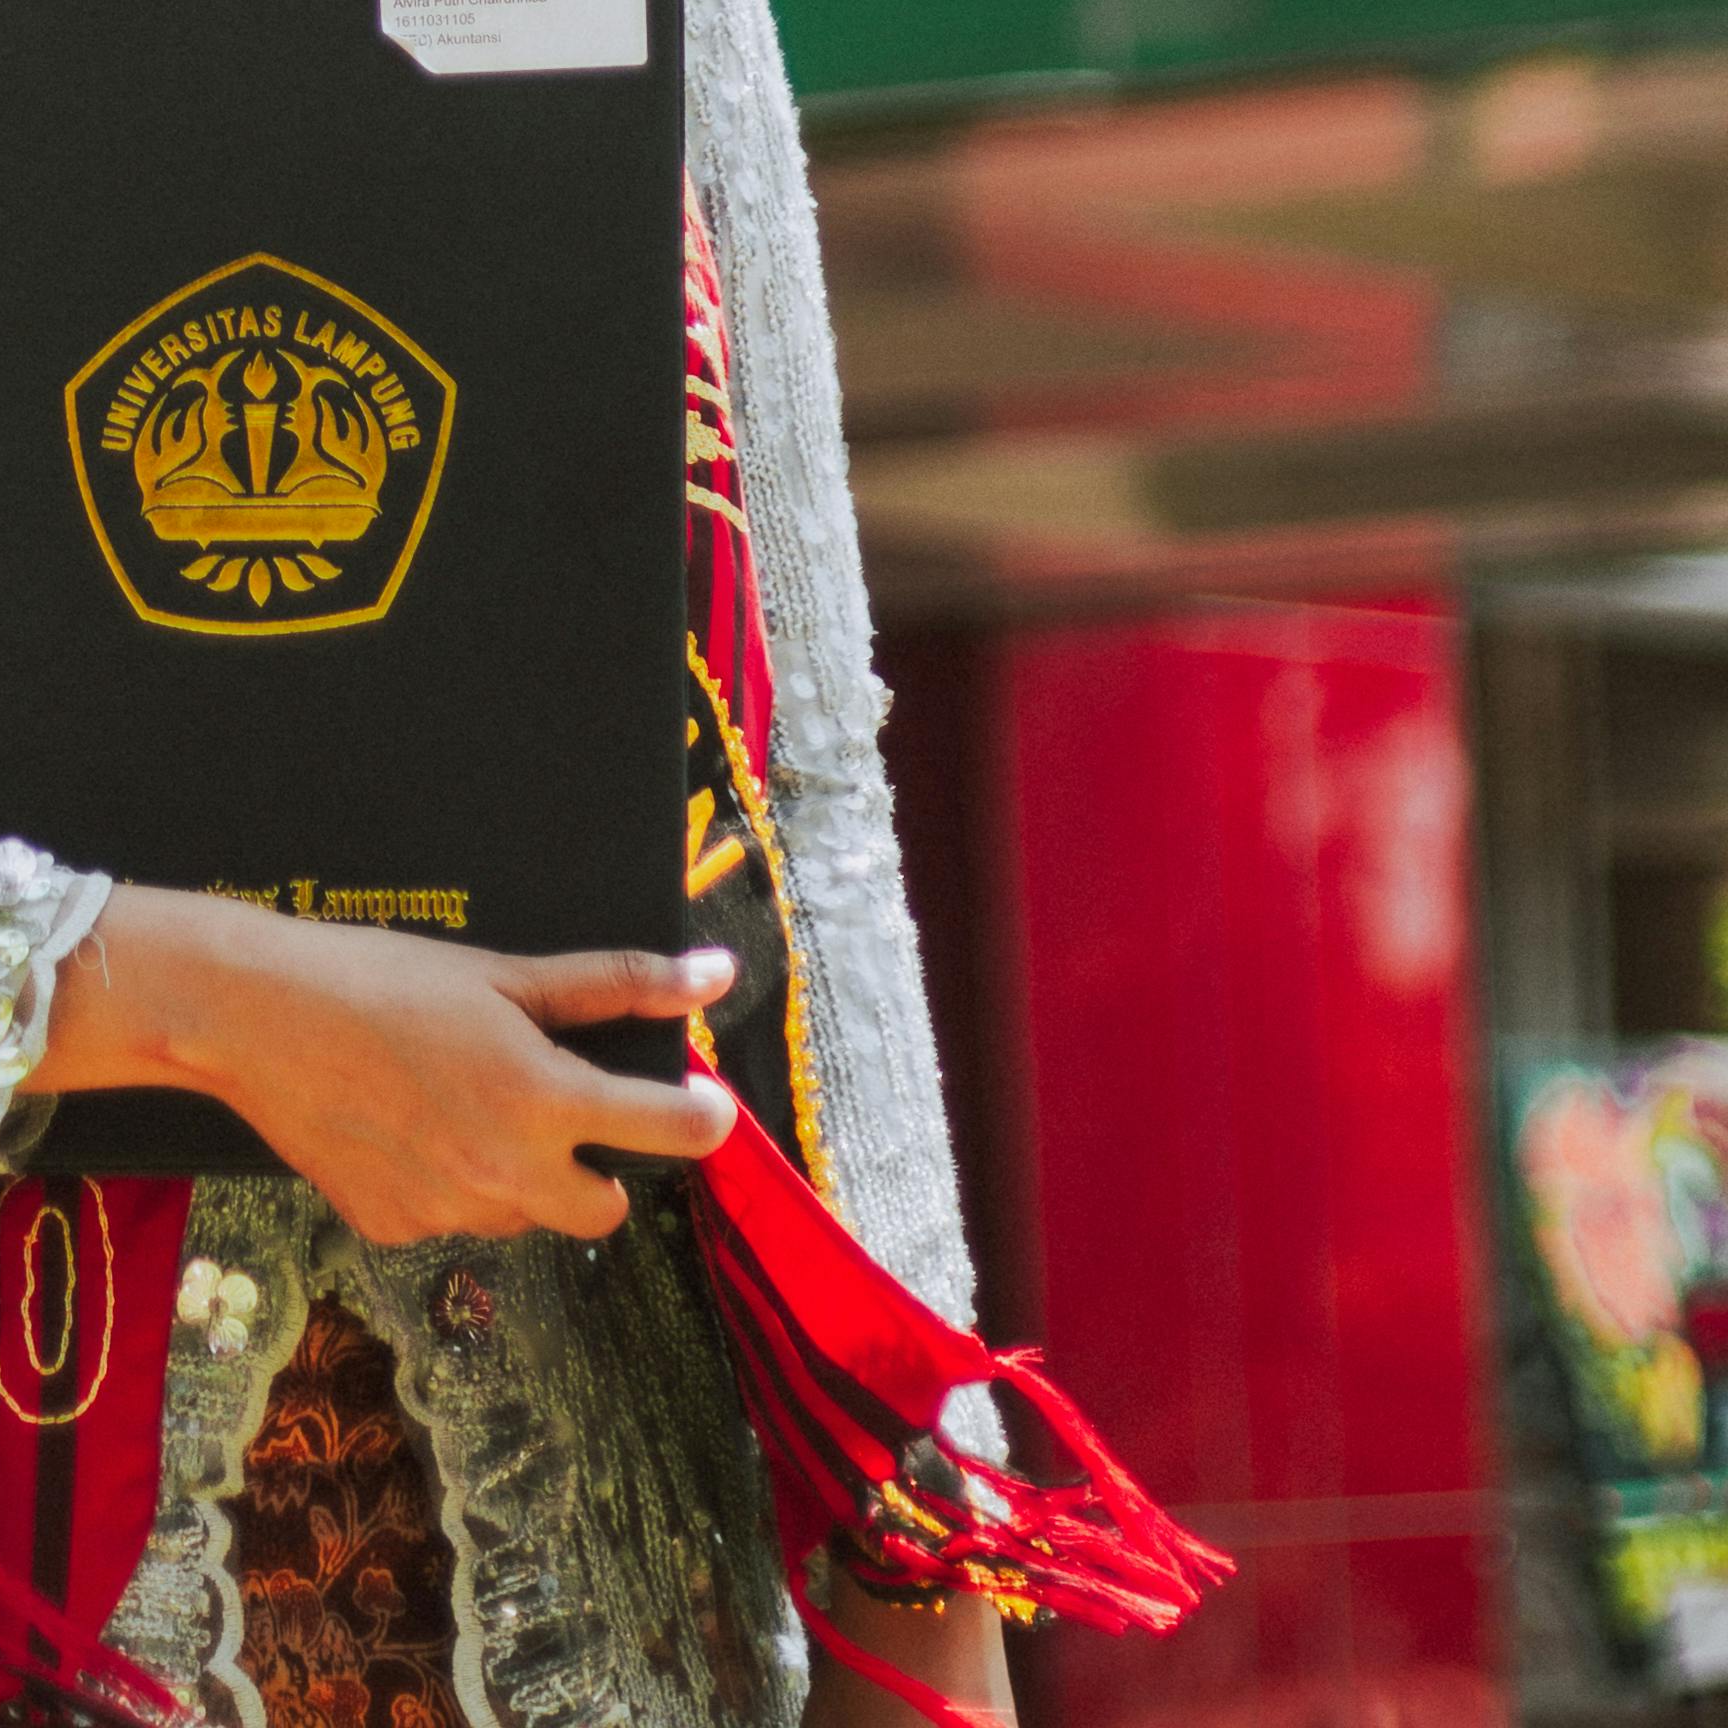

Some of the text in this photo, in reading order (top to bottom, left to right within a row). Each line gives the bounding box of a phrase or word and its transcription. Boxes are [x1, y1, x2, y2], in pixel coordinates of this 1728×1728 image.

[395, 12, 476, 28] 1611031105
[437, 32, 502, 46] Akuntansi
[101, 306, 420, 451] UNIVERSITAS LAMPUNG
[289, 878, 469, 928] Lampung
